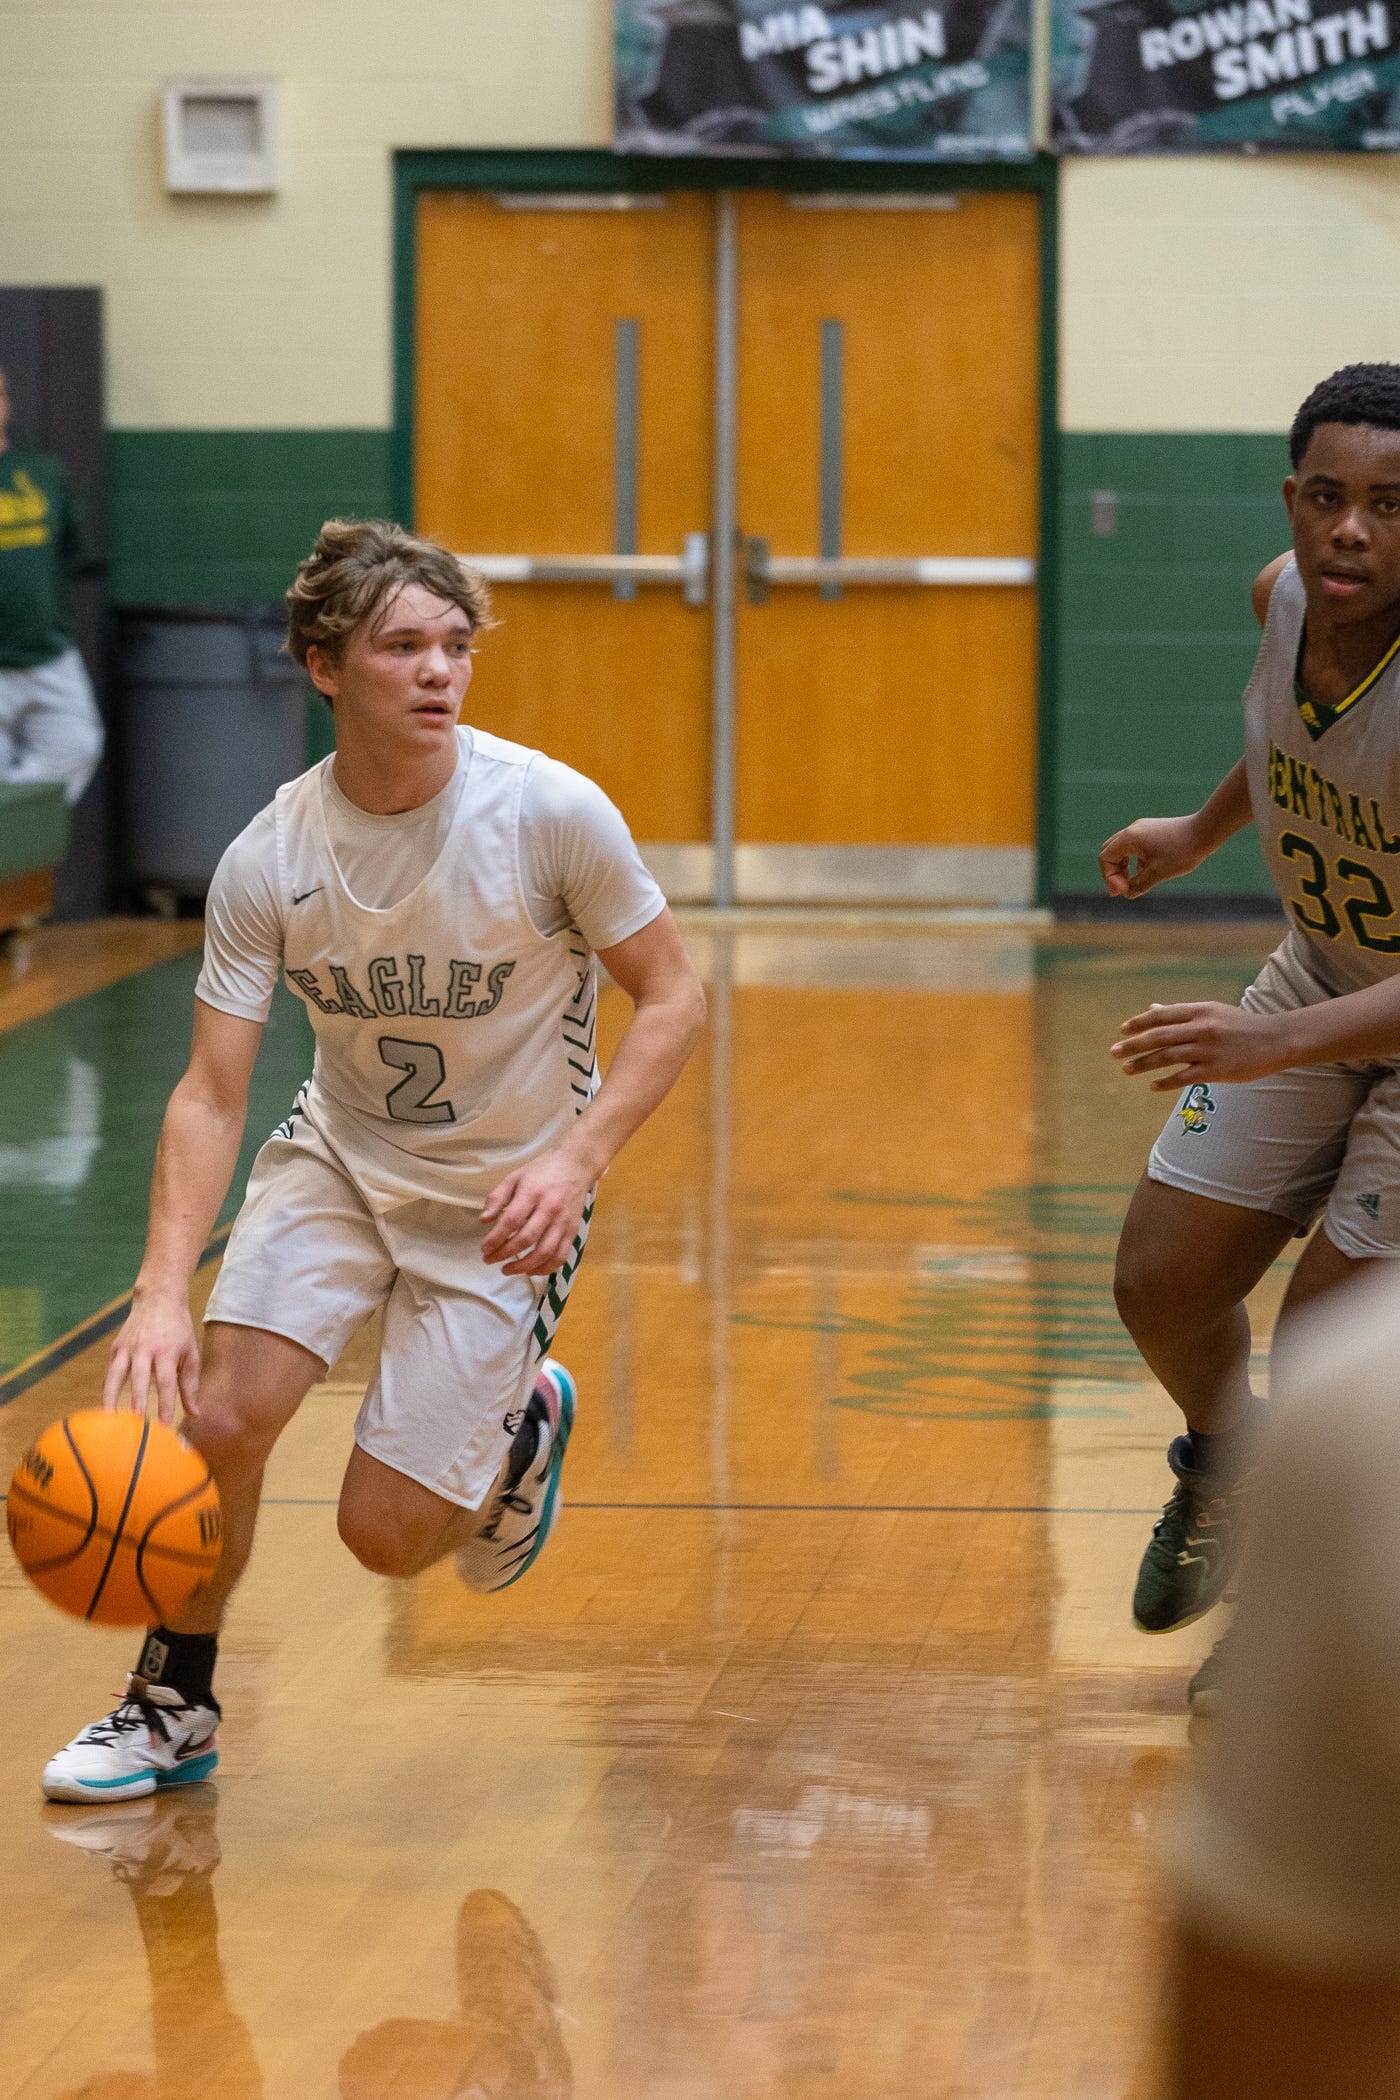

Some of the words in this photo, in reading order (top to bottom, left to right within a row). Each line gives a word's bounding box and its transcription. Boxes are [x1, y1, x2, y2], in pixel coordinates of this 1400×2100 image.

[739, 4, 832, 62] MIA
[805, 9, 946, 92] SHIN
[1139, 0, 1312, 71] ROWAN
[1211, 2, 1391, 100] SMITH
[1279, 829, 1400, 955] 32
[286, 954, 516, 1019] EAGLES
[377, 1036, 456, 1124] 2
